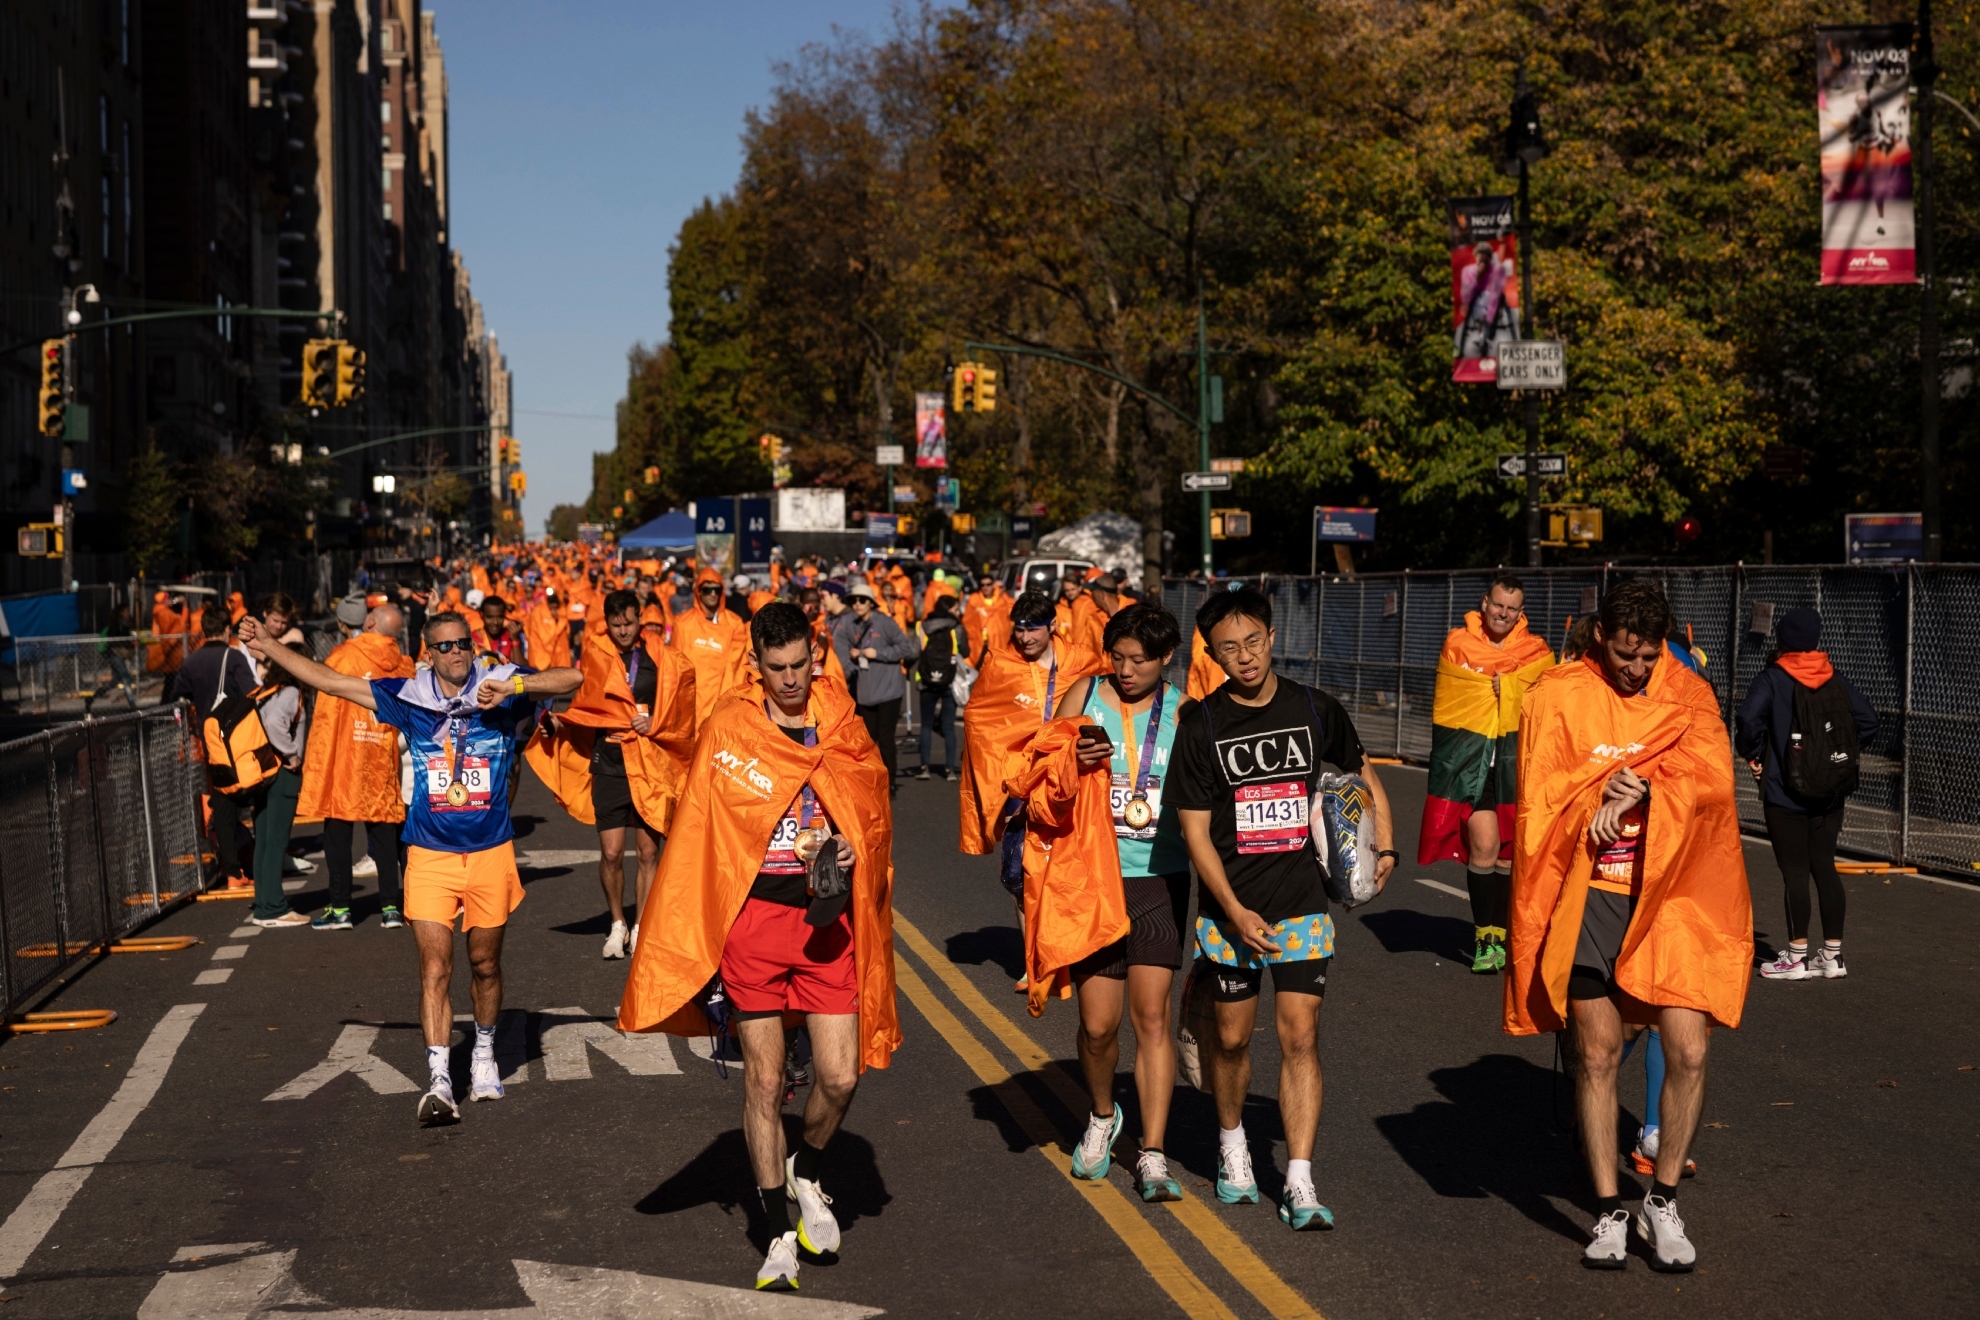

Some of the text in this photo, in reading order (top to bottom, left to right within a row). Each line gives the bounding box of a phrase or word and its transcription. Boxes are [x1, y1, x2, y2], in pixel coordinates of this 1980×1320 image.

[1850, 48, 1909, 64] NOV 03
[1471, 214, 1496, 227] NOV
[1501, 347, 1561, 361] PASSENGER
[1501, 364, 1560, 379] CARS ONLY
[1508, 459, 1527, 471] ONE
[705, 516, 726, 532] A-D
[748, 516, 766, 532] A-D
[1227, 735, 1308, 777] CCA
[438, 770, 481, 788] 508
[720, 767, 734, 779] YORK
[732, 775, 747, 787] ROAD
[746, 785, 771, 801] RUNNERS
[1244, 788, 1260, 799] tcs
[1246, 799, 1301, 824] 11431
